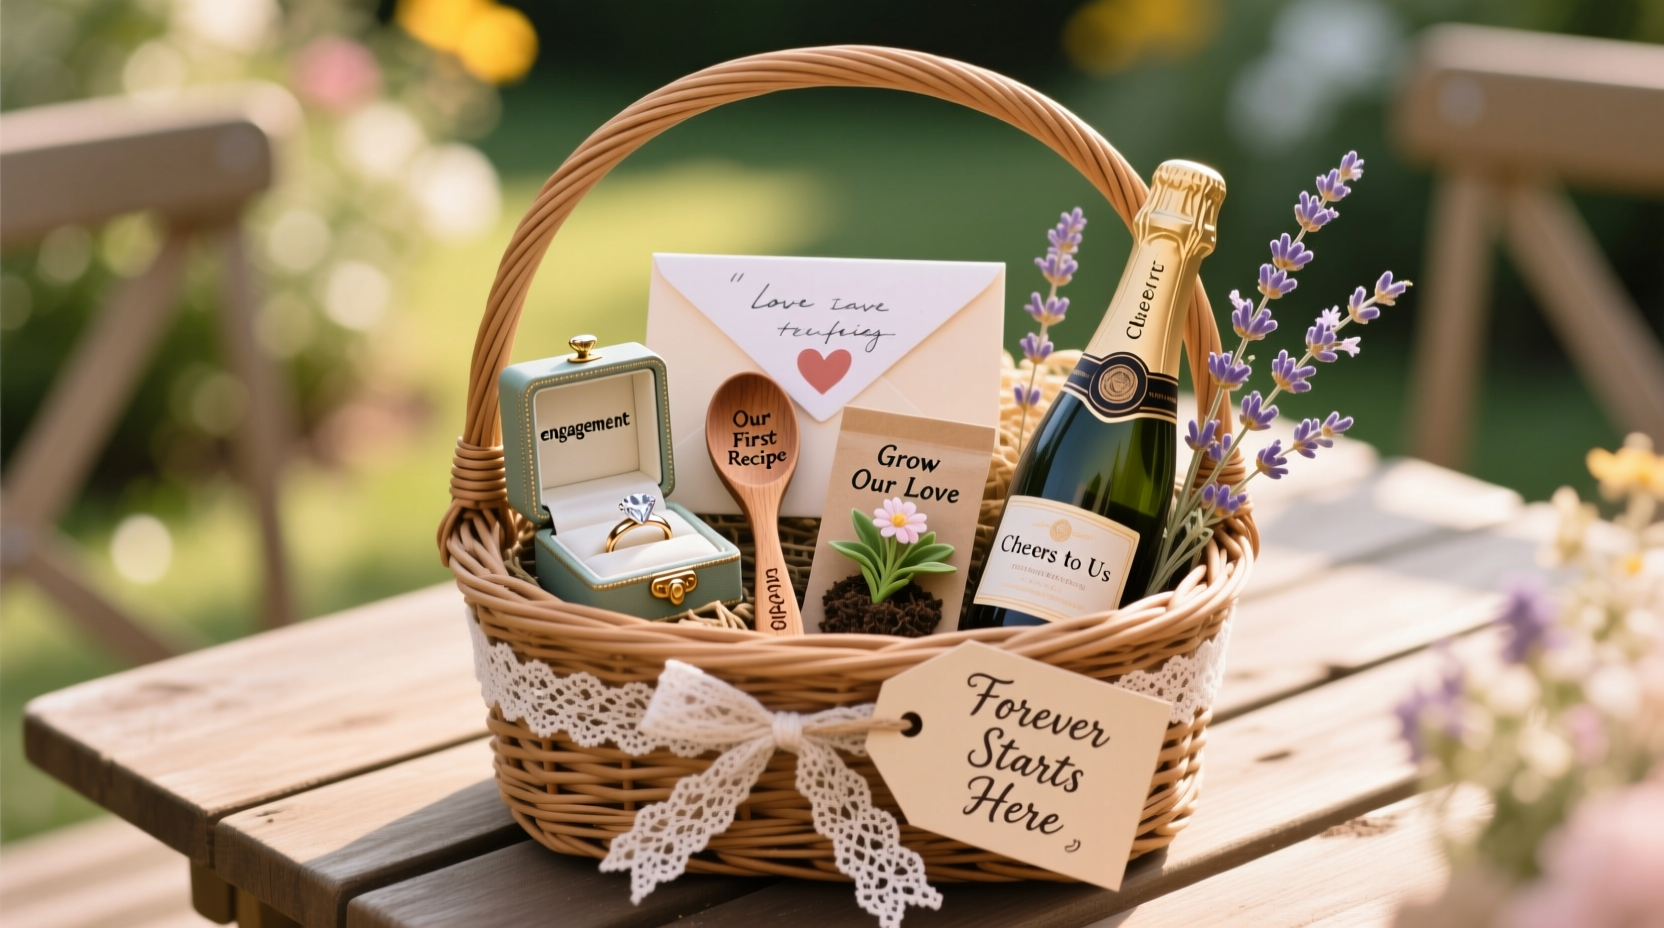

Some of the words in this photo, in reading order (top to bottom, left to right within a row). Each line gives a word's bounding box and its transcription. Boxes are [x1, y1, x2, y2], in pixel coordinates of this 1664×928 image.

[751, 283, 815, 309] Love
[540, 412, 630, 443] engagement
[733, 410, 771, 428] Our
[733, 430, 777, 448] First
[728, 450, 787, 469] Recipe
[877, 444, 941, 473] Grow
[851, 468, 897, 493] Our
[904, 477, 960, 503] Love
[1001, 535, 1057, 563] Cheers
[1064, 551, 1081, 570] to
[1088, 557, 1111, 582] Us
[967, 673, 1110, 748] Forever
[967, 727, 1084, 793] Starts
[962, 776, 1064, 835] Here
